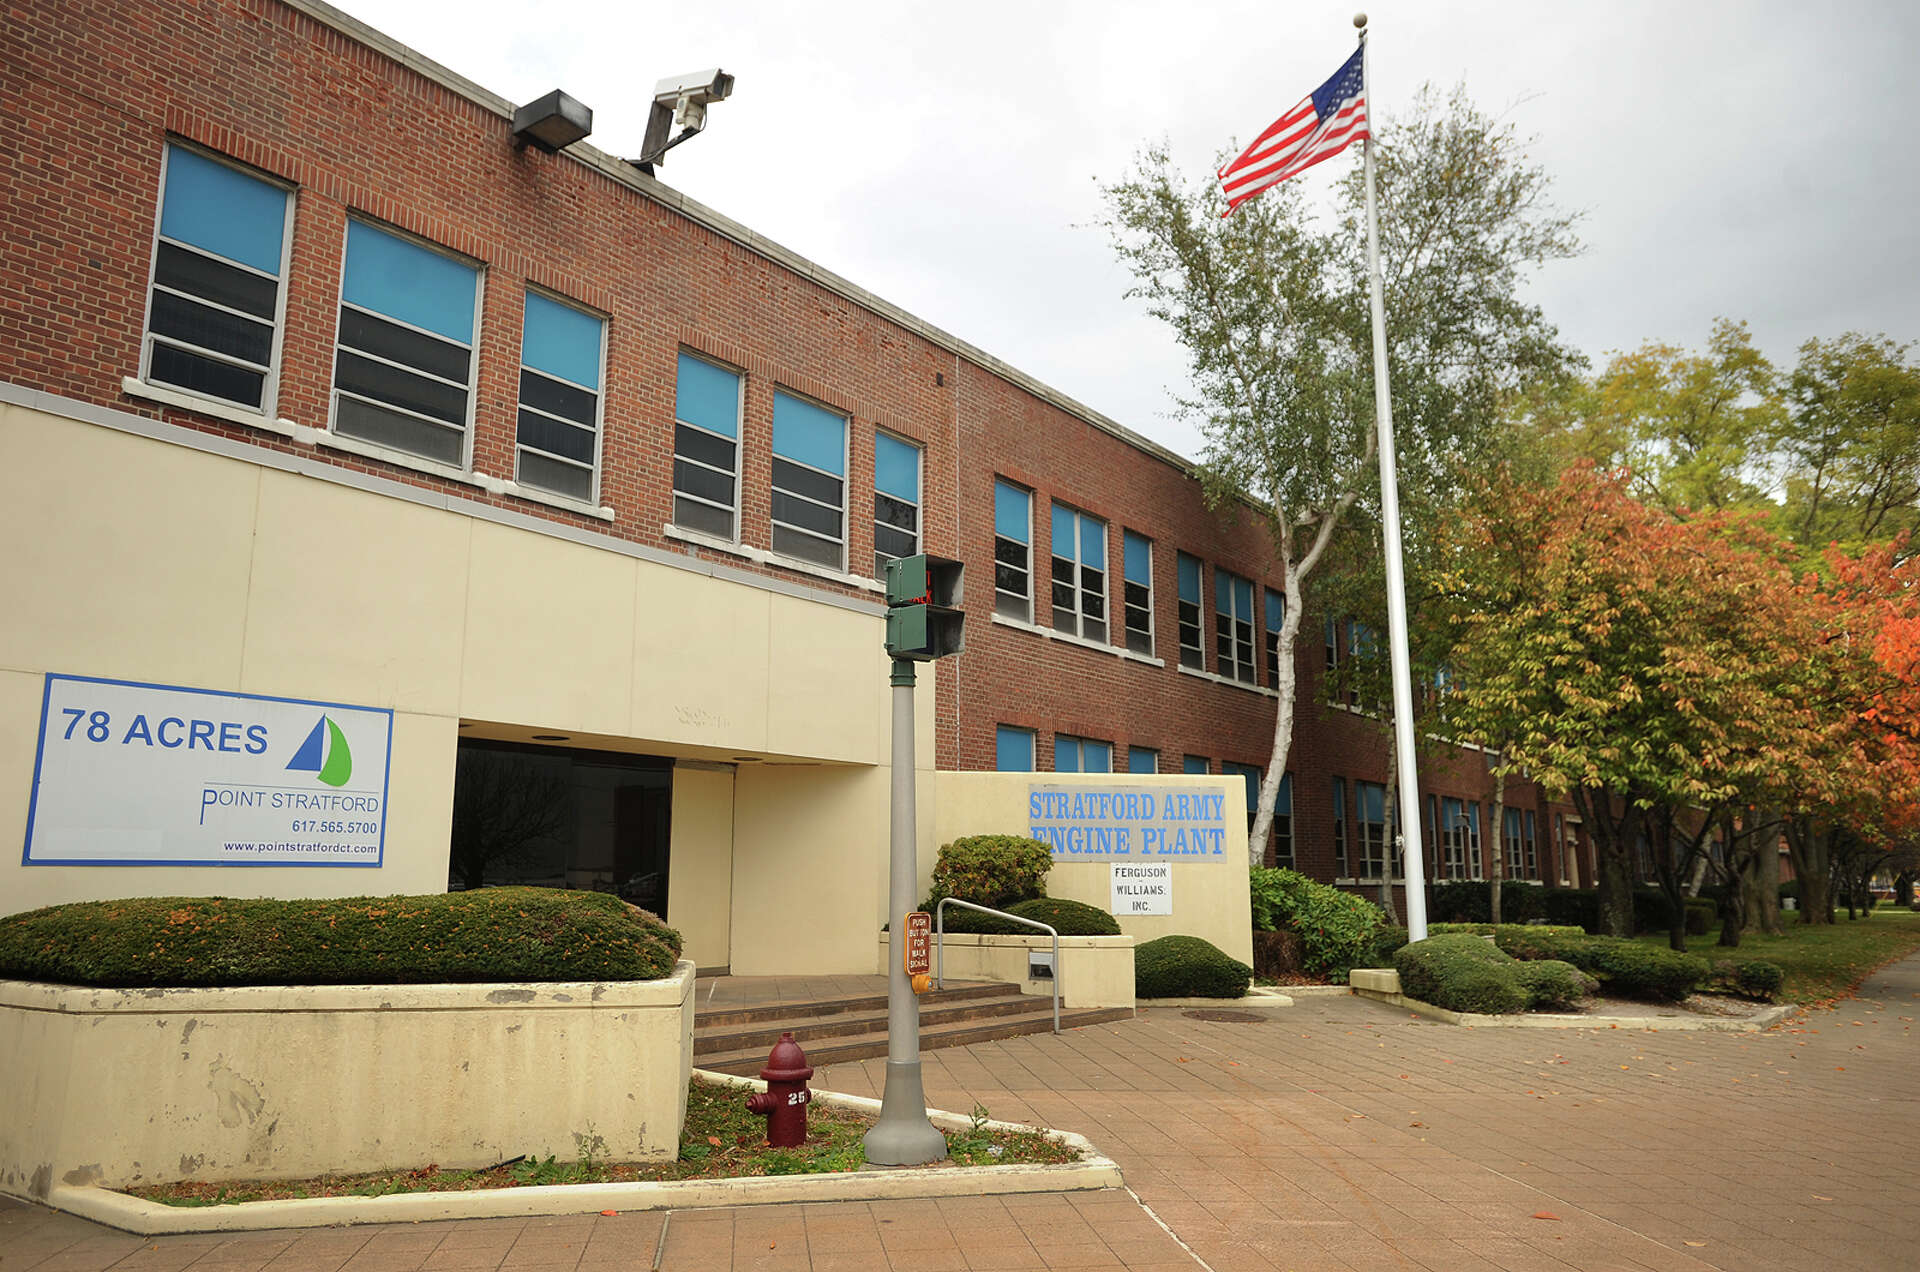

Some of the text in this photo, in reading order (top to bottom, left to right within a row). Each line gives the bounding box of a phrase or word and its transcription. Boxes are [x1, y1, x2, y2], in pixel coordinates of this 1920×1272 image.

[61, 708, 269, 755] 78 ACRES
[200, 789, 379, 825] POINT STRATFORD
[1029, 791, 1225, 821] STRATFORD ARMY
[291, 820, 378, 834] 617.565.5700
[223, 841, 378, 854] www.pointstratfordct.com
[1141, 828, 1225, 855] PLANT
[1115, 867, 1167, 878] FERGUSON
[1132, 901, 1152, 912] INC.
[788, 1091, 805, 1105] 25
